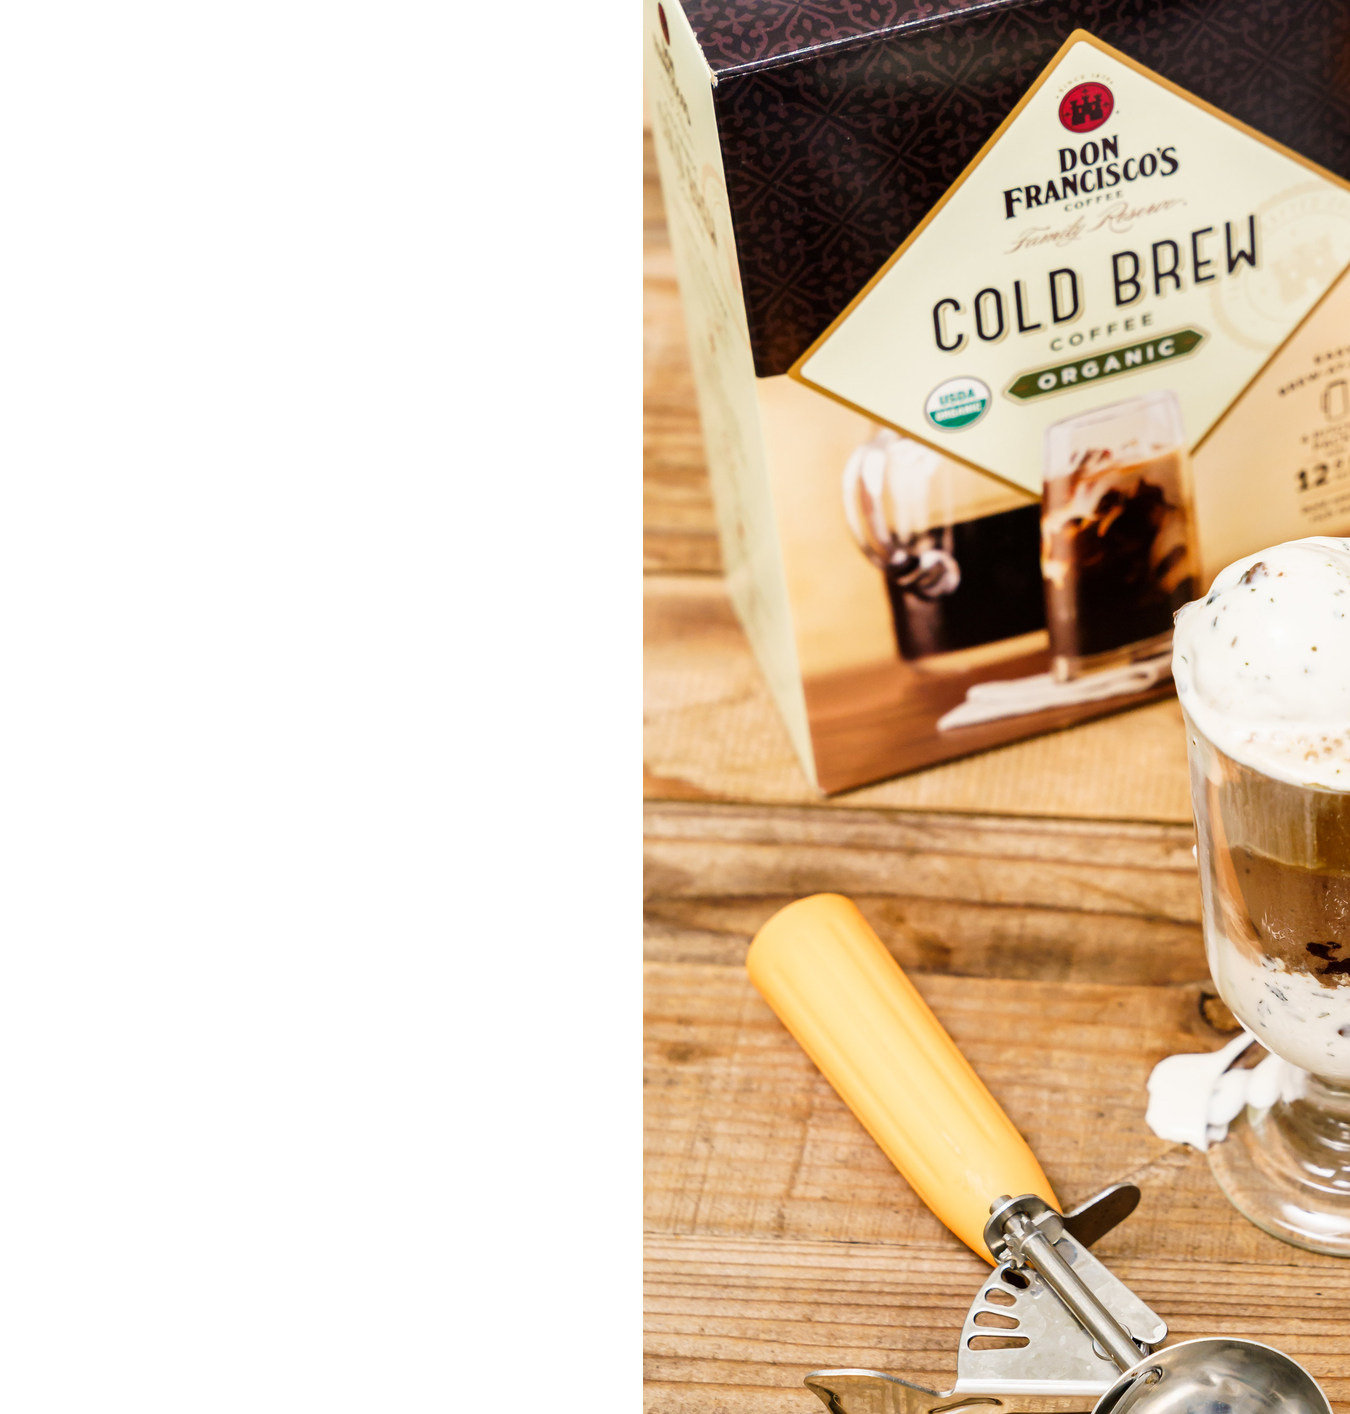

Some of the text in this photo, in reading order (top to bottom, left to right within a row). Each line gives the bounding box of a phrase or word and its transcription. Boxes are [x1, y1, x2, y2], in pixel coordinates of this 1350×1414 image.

[1058, 135, 1119, 173] DON
[1003, 147, 1179, 220] FRANCISCO'S
[1064, 190, 1124, 212] COFFEE
[1003, 215, 1085, 254] Family
[932, 267, 1081, 353] COLD
[1112, 215, 1257, 307] BREW
[1050, 313, 1154, 352] COFFEE
[1037, 338, 1176, 391] ORGANIC
[938, 387, 976, 405] USDA
[1297, 463, 1329, 492] 12
